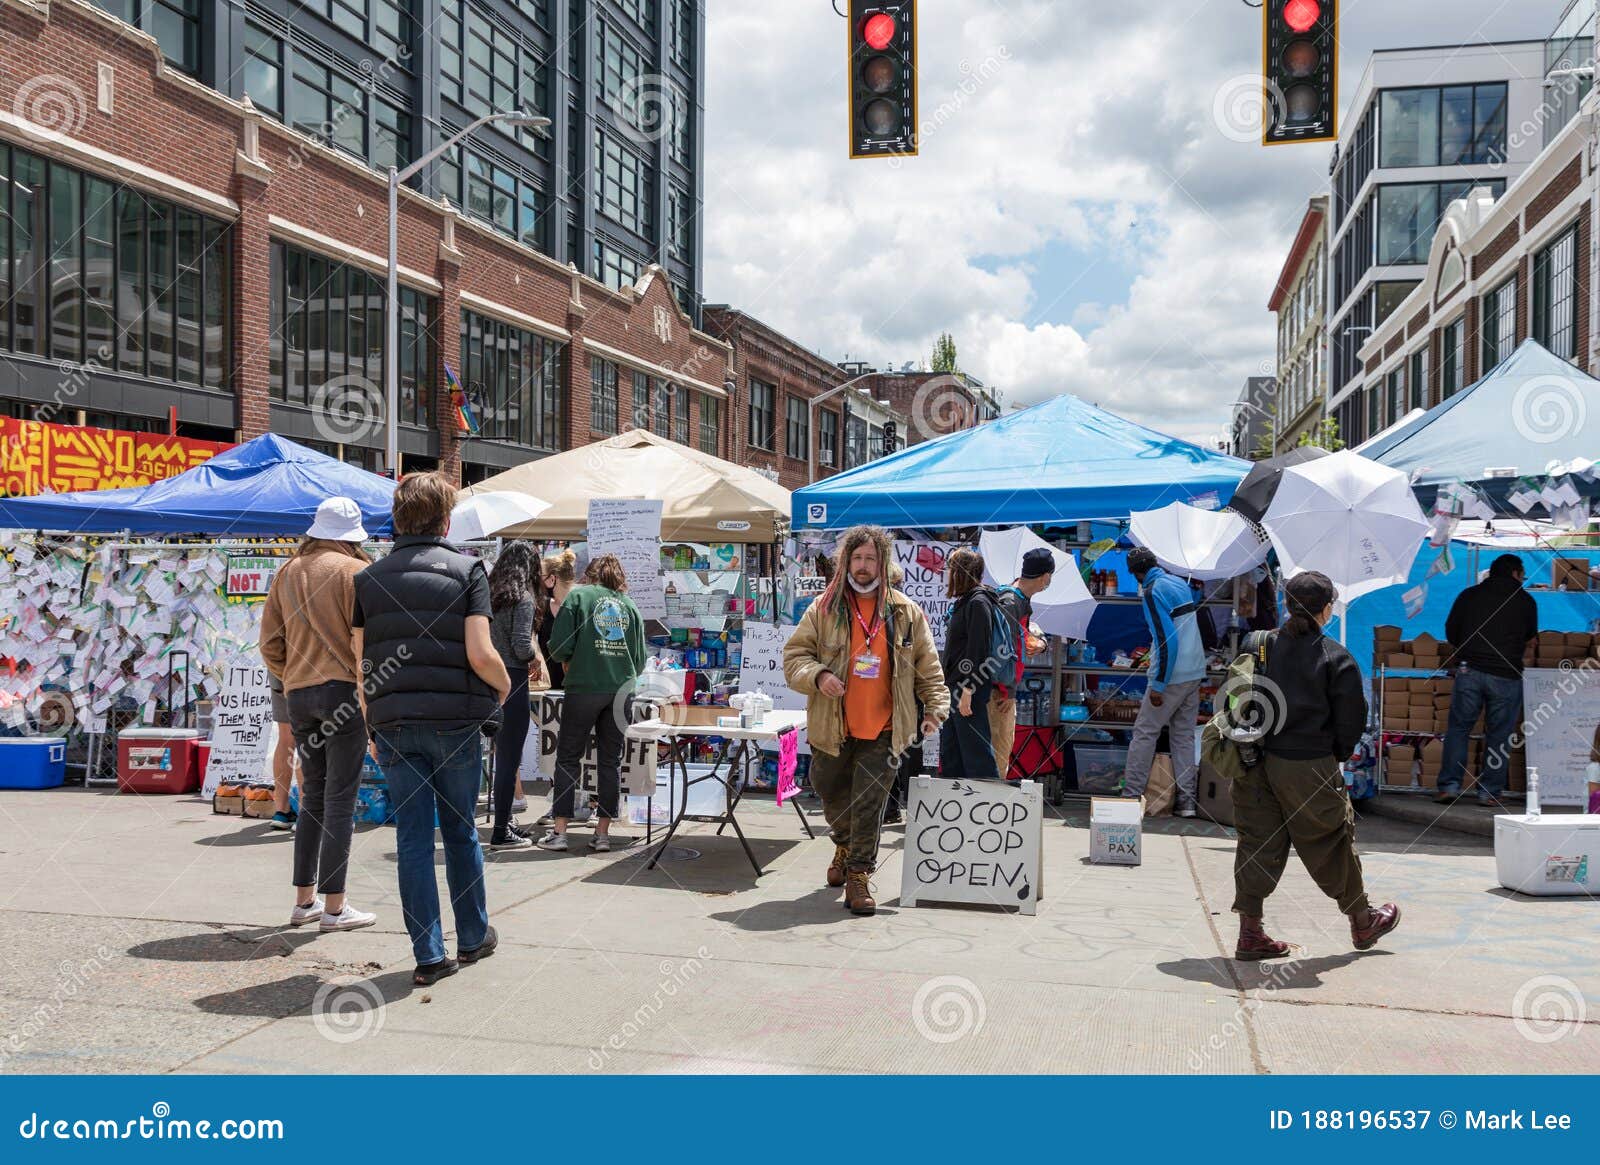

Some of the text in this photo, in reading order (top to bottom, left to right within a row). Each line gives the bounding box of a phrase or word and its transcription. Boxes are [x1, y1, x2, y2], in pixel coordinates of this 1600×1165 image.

[229, 558, 276, 570] MENTAL
[229, 573, 261, 592] NOT
[742, 656, 784, 672] Every Da
[220, 691, 272, 708] US HELPIN
[248, 713, 261, 725] WE
[914, 798, 1028, 827] NO COP
[916, 825, 1024, 854] CO-OP
[1108, 834, 1136, 845] BULK
[1108, 843, 1137, 857] PAX
[916, 858, 1025, 887] OPEN
